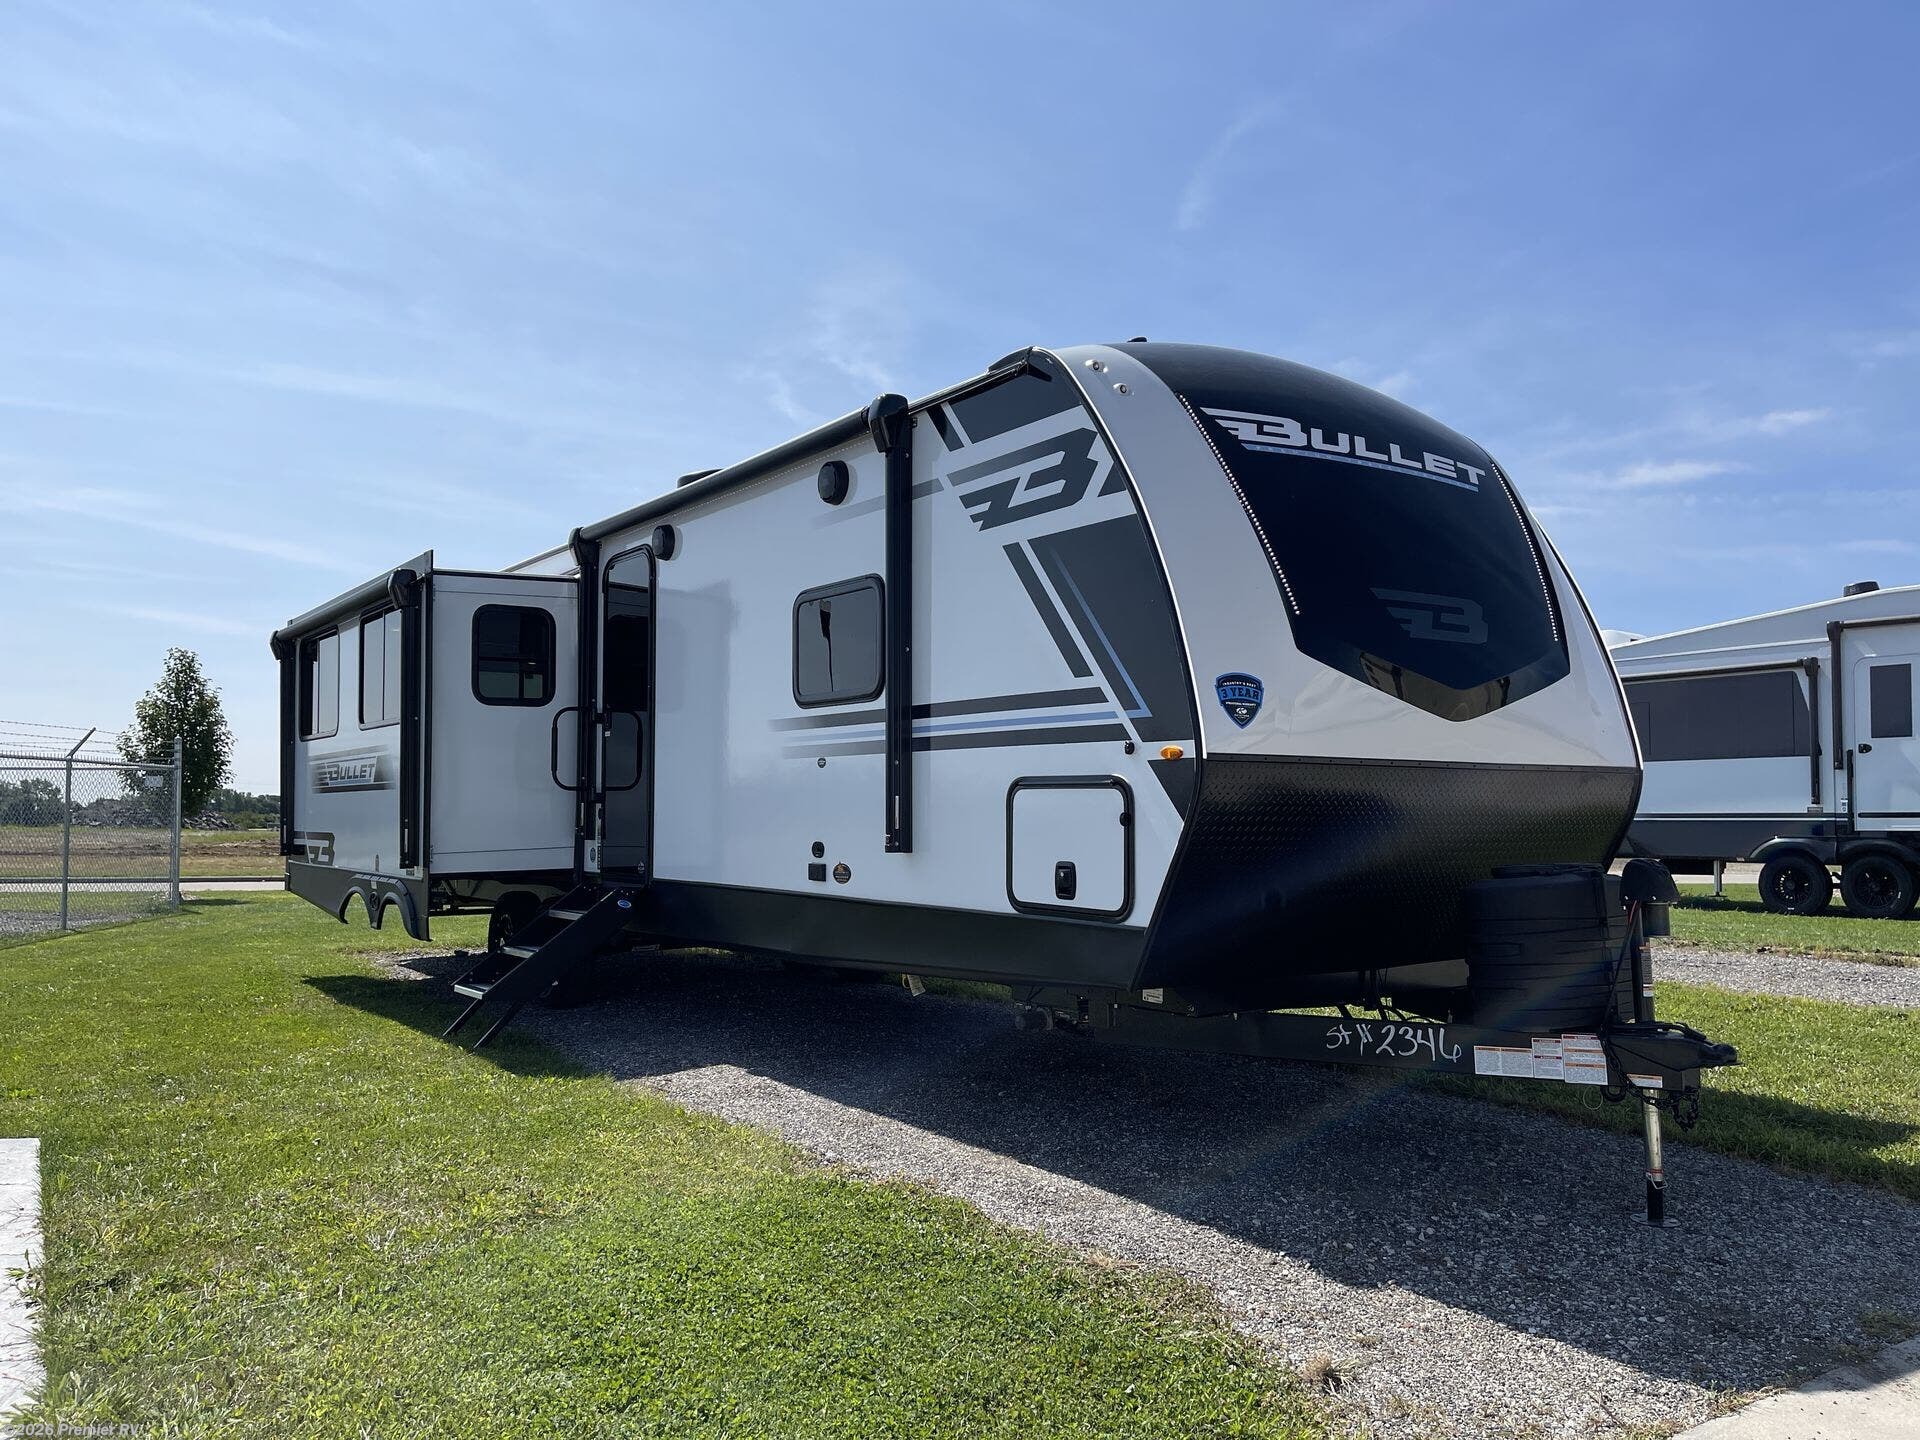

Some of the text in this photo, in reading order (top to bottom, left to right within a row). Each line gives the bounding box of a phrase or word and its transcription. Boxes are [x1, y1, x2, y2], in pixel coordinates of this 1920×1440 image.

[1199, 407, 1486, 485] BULLET
[1221, 687, 1260, 699] 3 YEAR
[326, 762, 375, 781] BULLET
